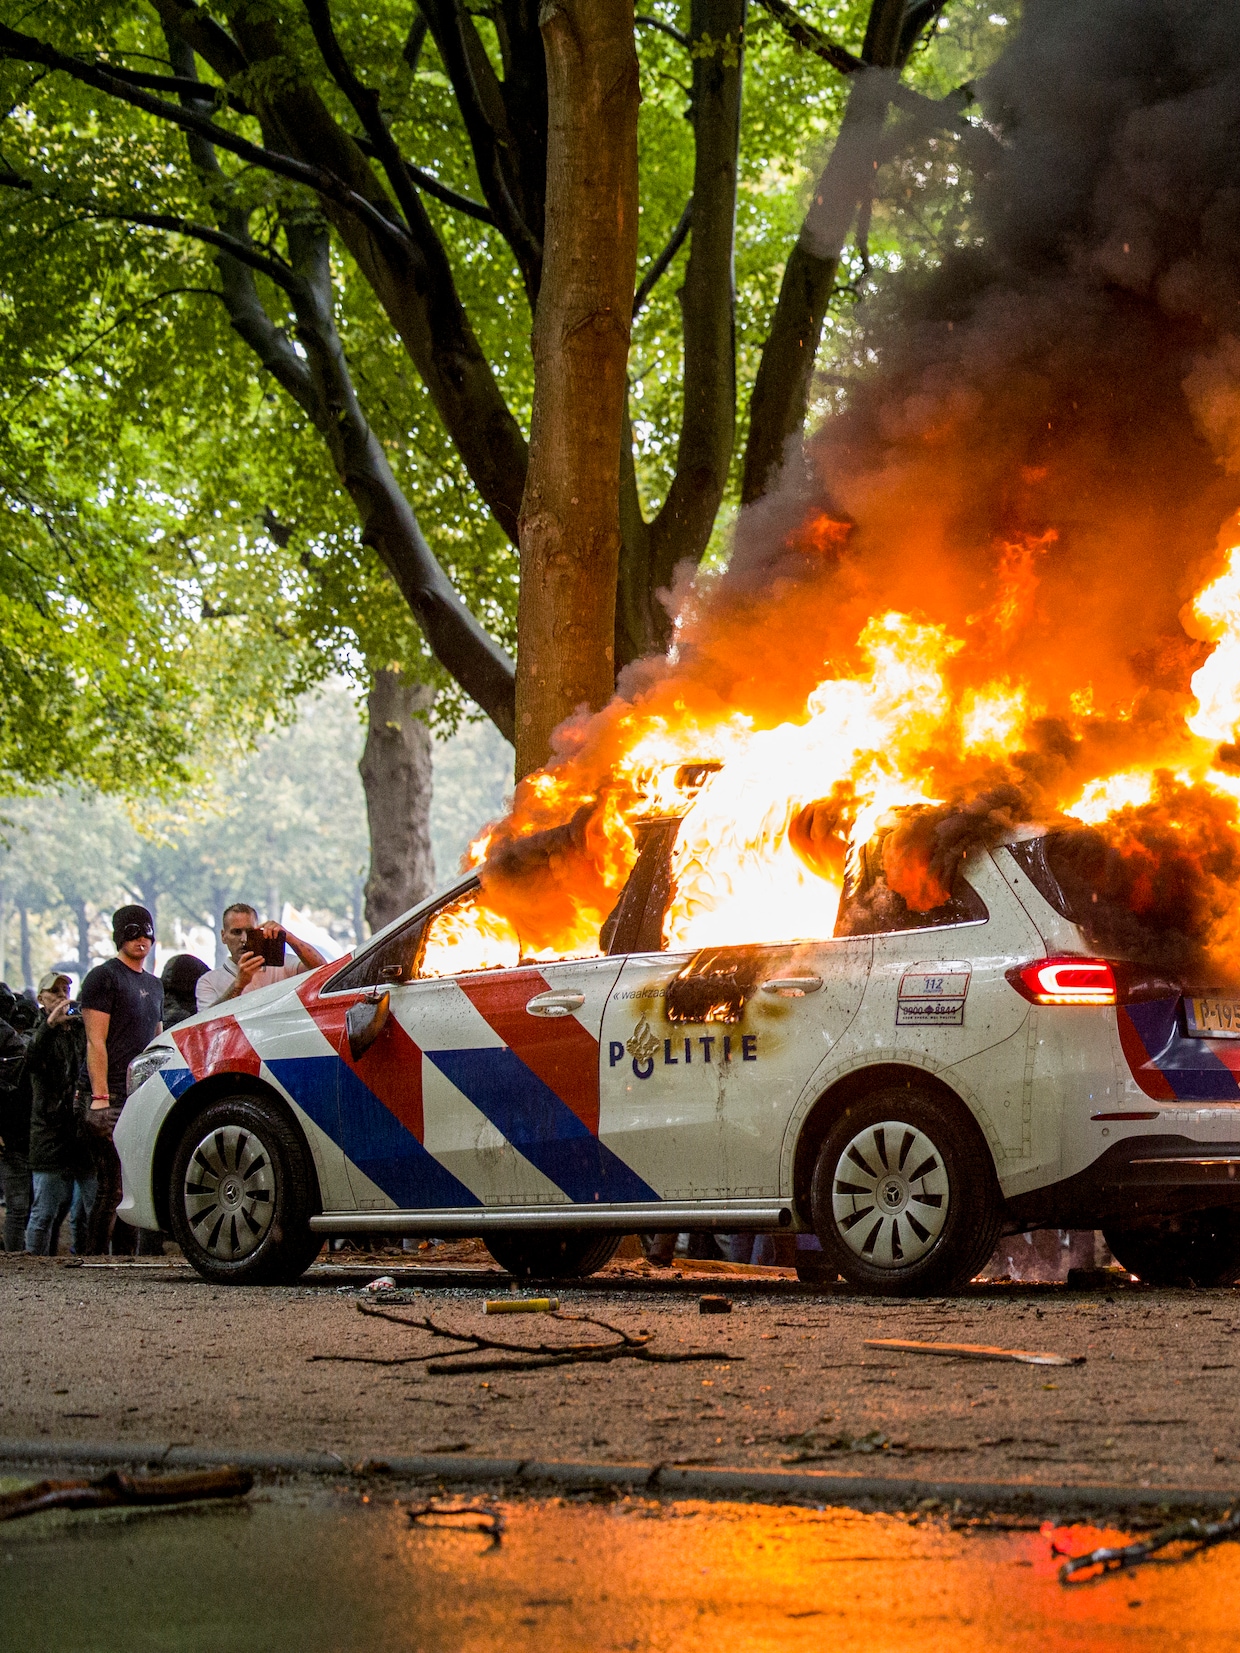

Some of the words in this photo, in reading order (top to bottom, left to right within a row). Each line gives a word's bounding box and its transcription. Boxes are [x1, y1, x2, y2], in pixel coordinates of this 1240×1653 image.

[925, 978, 943, 990] 112
[621, 987, 671, 999] waakzaa
[609, 1035, 757, 1079] POLITIE
